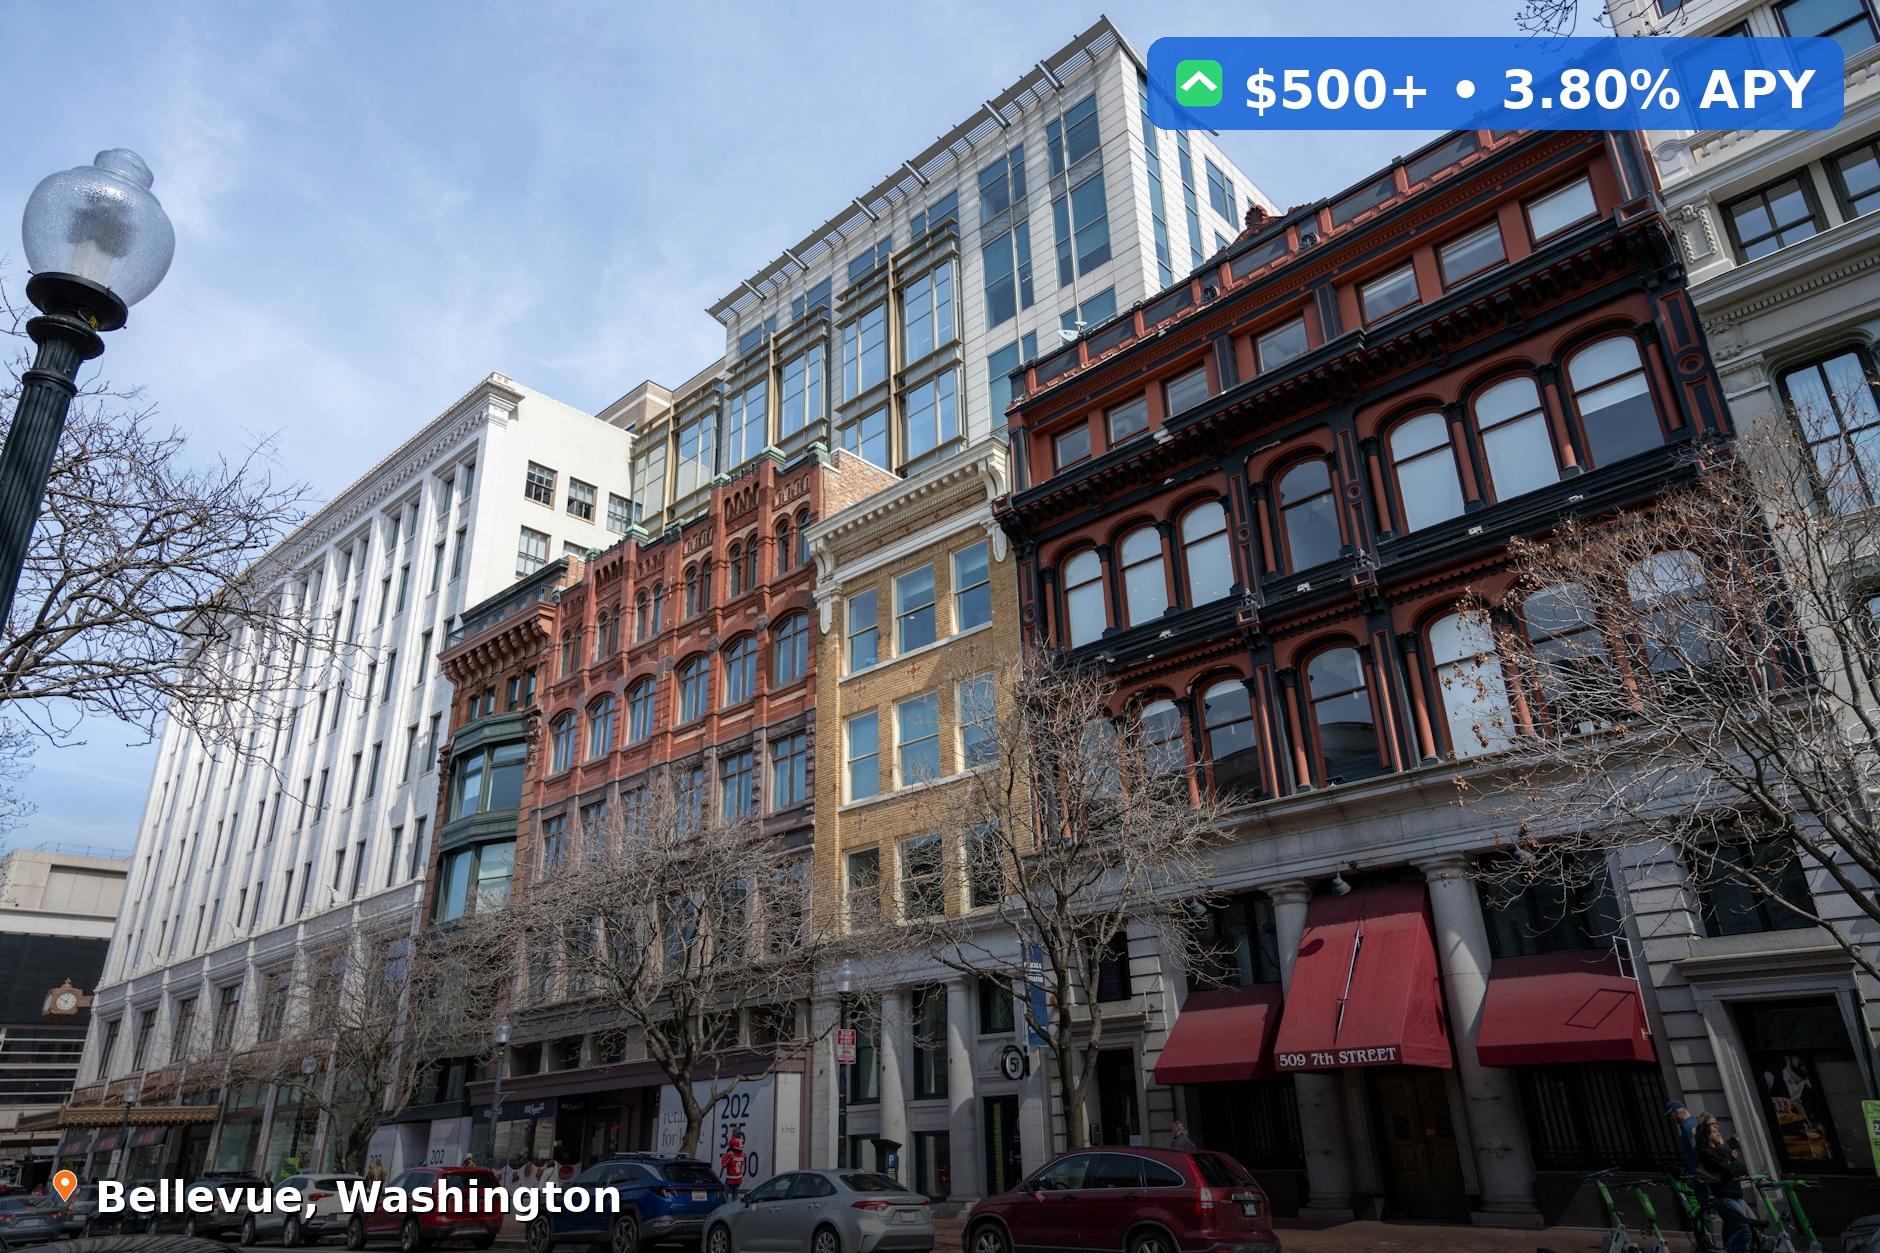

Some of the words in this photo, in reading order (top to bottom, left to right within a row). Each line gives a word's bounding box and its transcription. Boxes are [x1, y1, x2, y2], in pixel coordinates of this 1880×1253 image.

[1280, 1054, 1306, 1067] 509
[1311, 1052, 1335, 1066] 7th
[1338, 1047, 1397, 1064] STREET
[721, 1093, 750, 1119] 202
